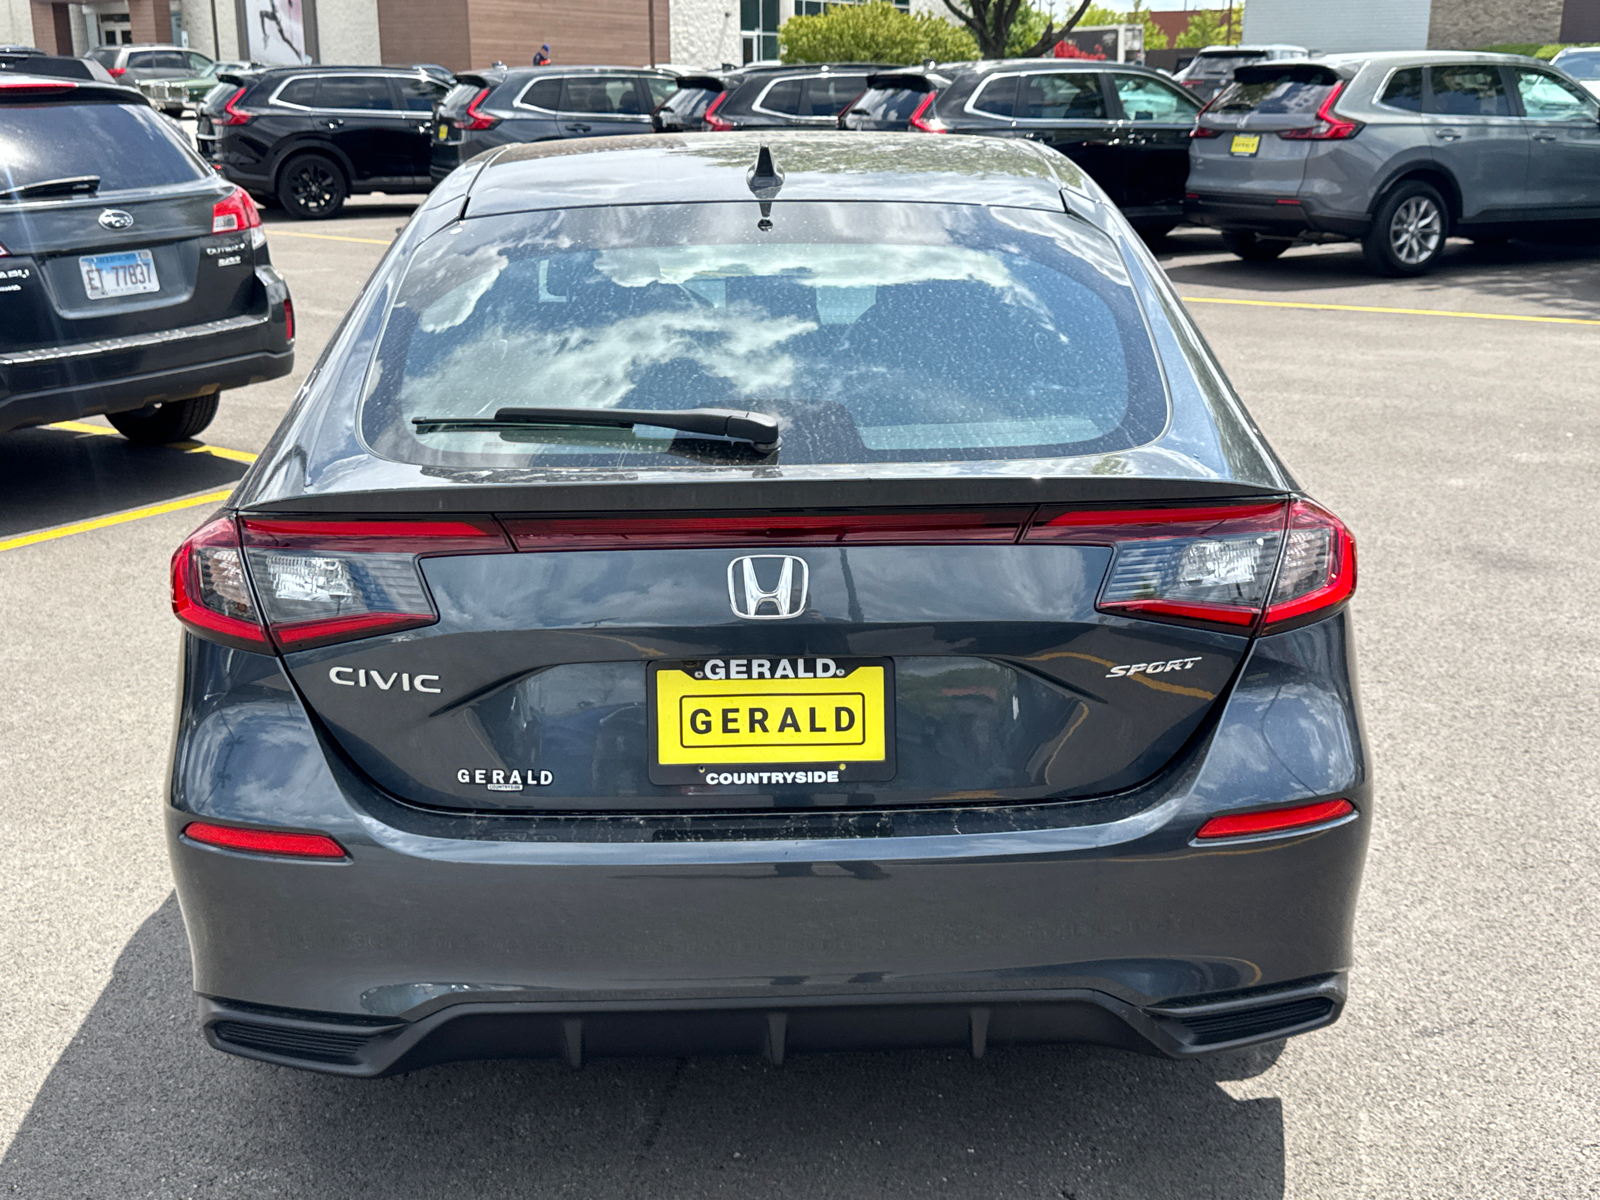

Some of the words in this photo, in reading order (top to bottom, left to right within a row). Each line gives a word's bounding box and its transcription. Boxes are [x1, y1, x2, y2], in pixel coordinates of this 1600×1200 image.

[86, 268, 104, 291] ET
[111, 262, 152, 287] 77837
[704, 658, 837, 680] GERALD
[1105, 656, 1203, 679] SPORT
[329, 666, 442, 694] CIVIC
[689, 706, 856, 735] GERALD
[457, 769, 553, 786] GERALD
[705, 770, 840, 786] COUNTRYSIDE
